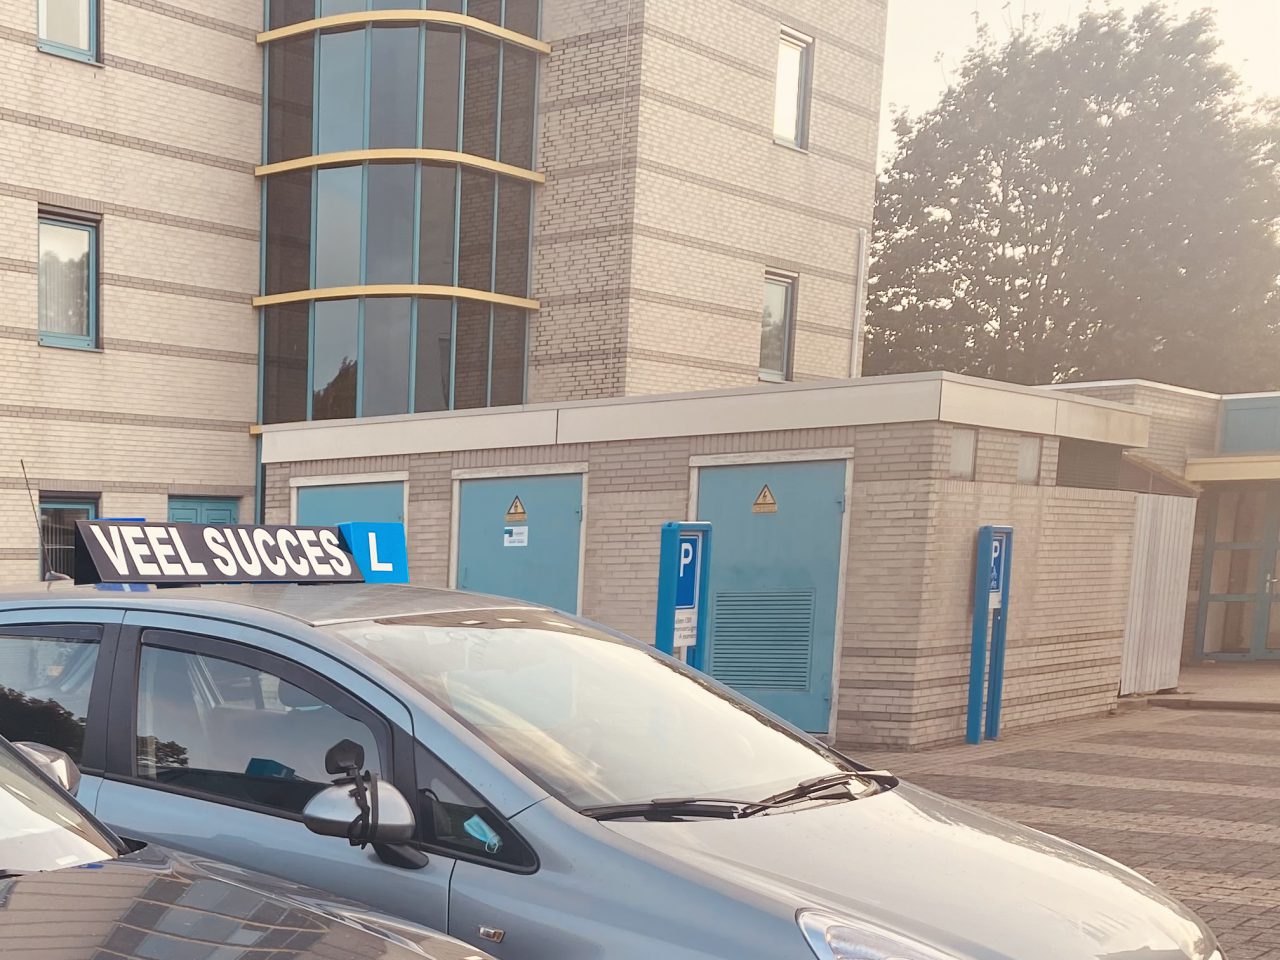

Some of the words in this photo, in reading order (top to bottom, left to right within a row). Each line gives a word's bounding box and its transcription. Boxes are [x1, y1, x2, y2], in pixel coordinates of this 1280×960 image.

[89, 524, 208, 576] VEEL
[202, 527, 352, 577] SUCCES
[368, 532, 393, 572] L
[680, 542, 693, 577] P
[991, 540, 1000, 567] P
